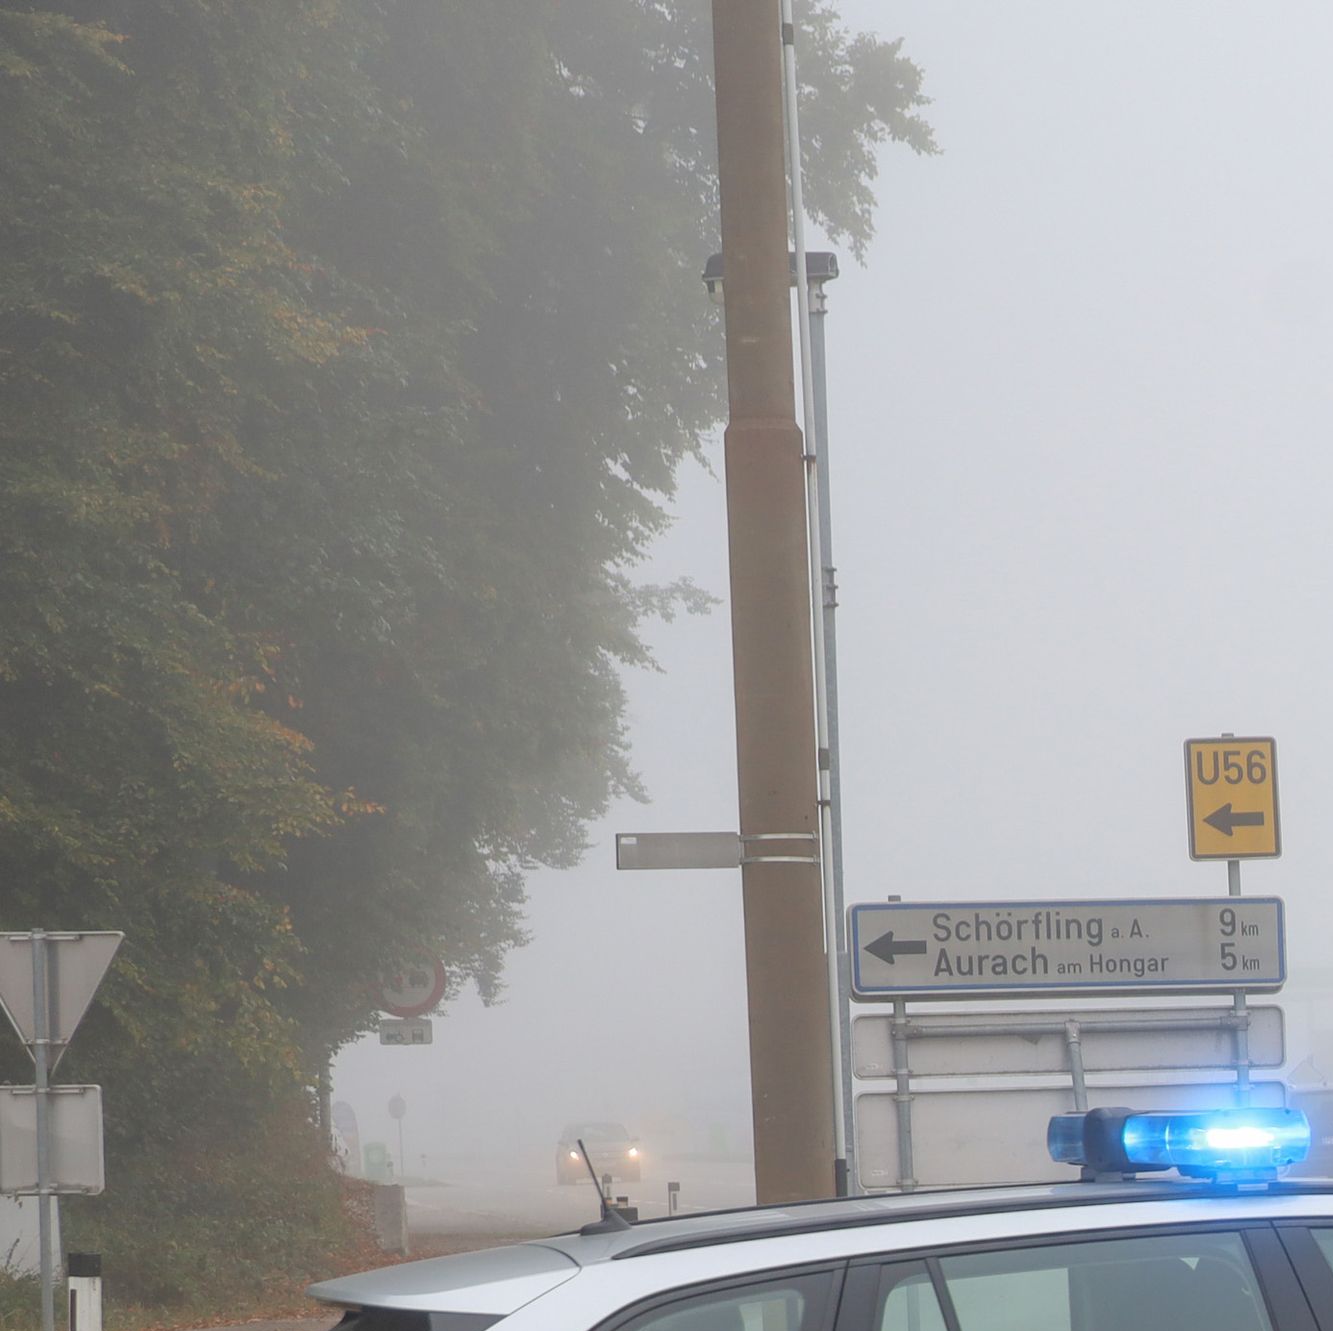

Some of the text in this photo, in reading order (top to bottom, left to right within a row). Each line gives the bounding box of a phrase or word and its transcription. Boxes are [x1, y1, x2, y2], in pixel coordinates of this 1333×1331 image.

[1196, 750, 1267, 786] U56
[932, 910, 1103, 947] Schörfling
[1129, 918, 1150, 939] A.
[1219, 908, 1236, 937] 9
[1240, 920, 1260, 937] km
[934, 942, 1260, 978] Aurach am Hongar 5 km
